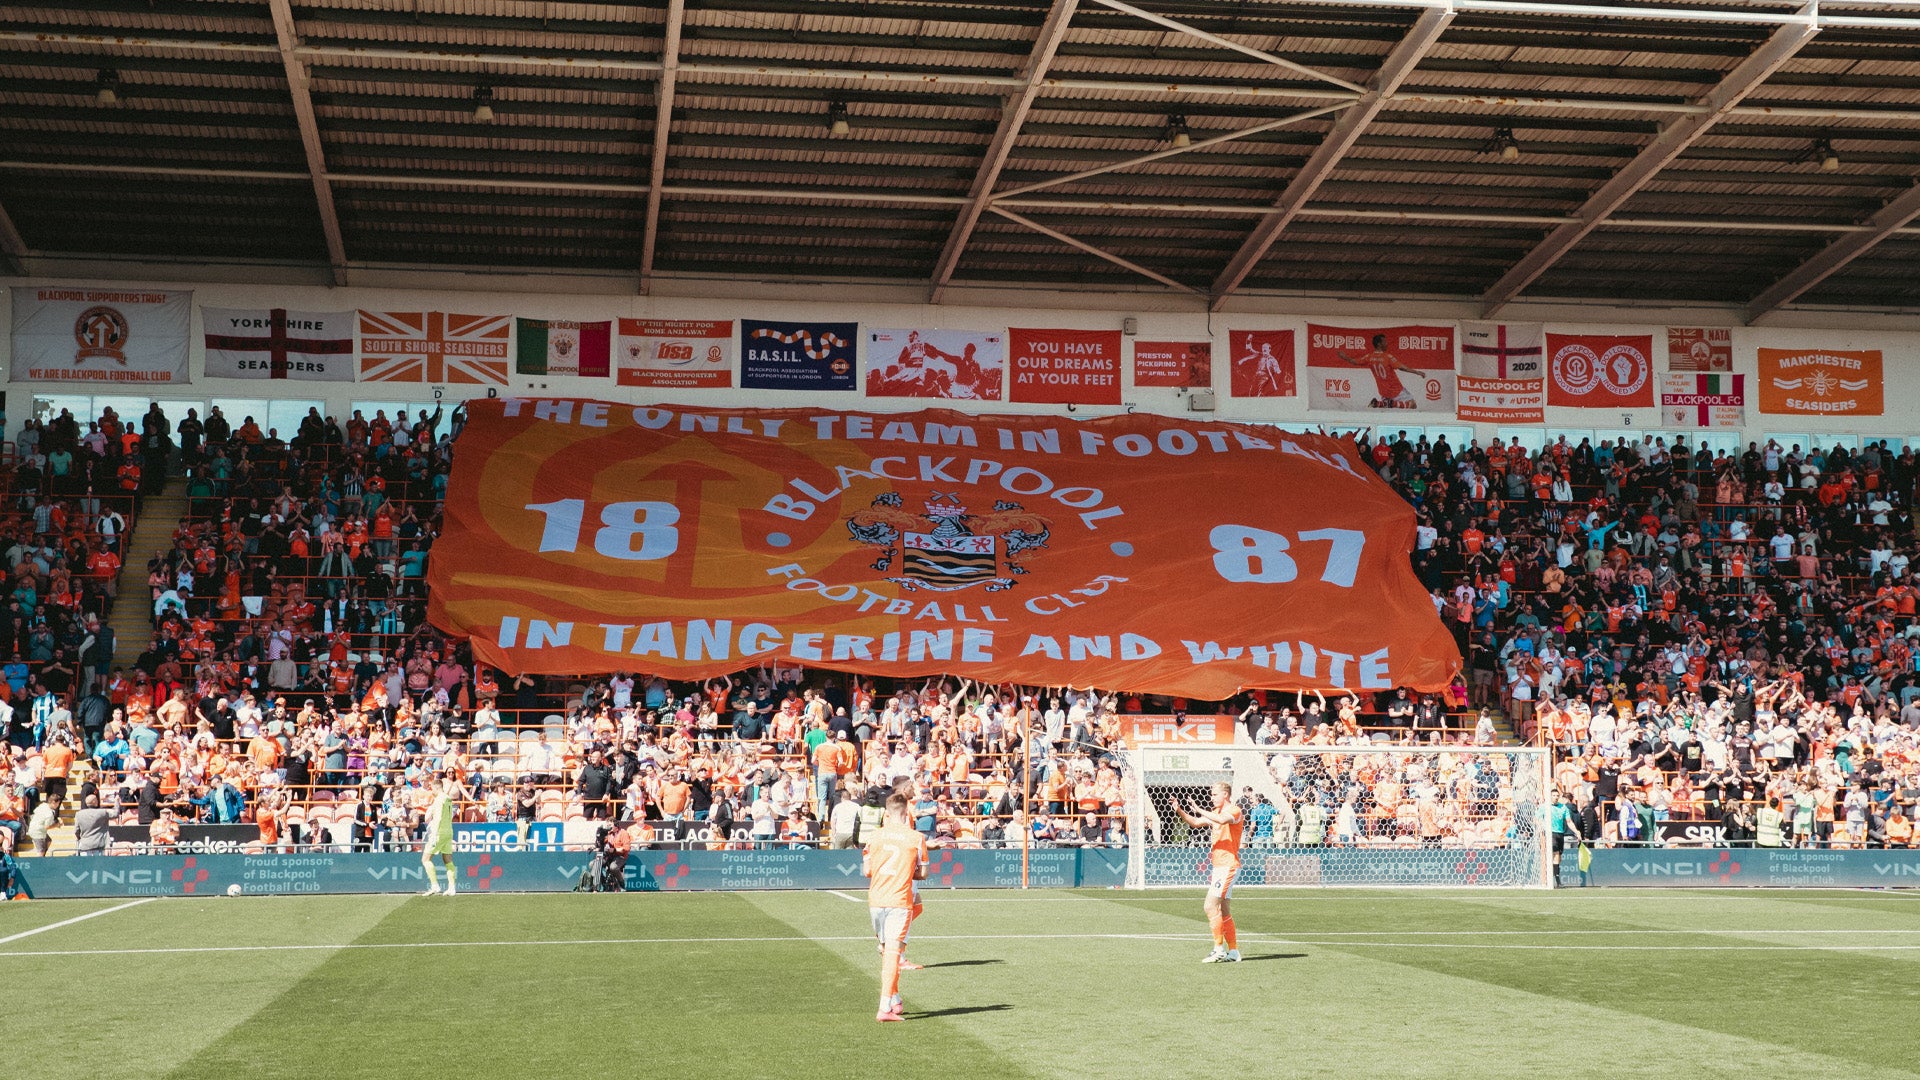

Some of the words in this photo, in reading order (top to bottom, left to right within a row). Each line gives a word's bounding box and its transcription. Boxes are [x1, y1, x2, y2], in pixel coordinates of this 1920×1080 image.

[37, 290, 85, 302] BLACKPOOL
[87, 291, 140, 303] SUPPORTERS
[141, 293, 167, 304] TRUST
[648, 320, 663, 328] THE
[665, 321, 694, 329] MIGHTY
[365, 340, 402, 353] SOUTH
[405, 341, 441, 354] SHORE
[444, 342, 504, 356] SEASIDERS
[1029, 342, 1059, 355] YOU
[1064, 342, 1103, 356] HAVE
[1313, 333, 1367, 351] SUPER
[1398, 335, 1450, 351] BRETT
[657, 341, 694, 360] bsa
[748, 349, 802, 363] B.A.S.I.L.
[1137, 352, 1173, 360] PRESTON
[1556, 345, 1598, 362] BLACKPOOL
[1614, 345, 1632, 354] LOVE
[1631, 349, 1646, 366] YOU
[238, 360, 325, 373] SEASIDERS
[1017, 356, 1051, 370] OUR
[1054, 357, 1114, 371] DREAMS
[1512, 361, 1538, 372] 2020
[1778, 354, 1862, 371] MANCHESTER
[29, 368, 43, 379] WE
[44, 369, 60, 380] ARE
[61, 370, 108, 381] BLACKPOOL
[109, 370, 150, 382] FOOTBALL
[151, 371, 172, 381] CLUB
[632, 371, 672, 379] BLACKPOOL
[1018, 373, 1035, 386] AT
[1039, 373, 1080, 387] YOUR
[1084, 374, 1114, 388] FEET
[1325, 378, 1352, 392] FY6
[1460, 380, 1527, 392] BLACKPOOL
[1527, 381, 1541, 391] FC
[1555, 374, 1586, 395] FOOTBALL
[1586, 376, 1600, 392] CLUB
[1603, 378, 1629, 395] INDEED
[434, 390, 442, 399] D
[487, 387, 497, 399] D
[1663, 395, 1725, 405] BLACKPOOL
[1726, 395, 1742, 405] FC
[1067, 403, 1077, 412] C
[1510, 396, 1541, 405] #UTMP
[1785, 397, 1858, 412] SEASIDERS
[1127, 406, 1135, 415] C
[1460, 409, 1473, 417] SIR
[1473, 410, 1504, 419] STANLEY
[1505, 411, 1542, 419] MATTHEWS
[502, 398, 610, 429] THE
[631, 408, 787, 439] ONLY
[809, 414, 979, 448] TEAM
[998, 427, 1063, 455] IN
[1624, 418, 1631, 426] B
[763, 455, 1125, 531] BLACKPOOL
[524, 498, 681, 562] 18
[1209, 525, 1366, 588] 87
[766, 562, 1009, 622] FOOTBALL
[498, 616, 575, 650] IN
[598, 618, 994, 664] TANGERINE
[1018, 632, 1162, 664] AND
[1179, 640, 1392, 689] WHITE
[1222, 757, 1232, 769] 2
[1685, 825, 1729, 847] SBK
[243, 857, 276, 870] Proud
[281, 857, 334, 870] sponsors
[721, 853, 753, 865] Proud
[757, 853, 806, 867] sponsors
[880, 843, 899, 876] 2
[1029, 853, 1076, 866] sponsors
[1769, 851, 1798, 863] Proud
[1801, 852, 1845, 865] sponsors
[721, 865, 733, 876] of
[736, 864, 789, 879] Blackpool
[994, 864, 1006, 873] of
[1622, 861, 1703, 876] VINCI
[1769, 864, 1780, 874] of
[1782, 863, 1830, 876] Blackpool
[65, 869, 162, 885] VINCI
[243, 869, 257, 881] of
[260, 869, 316, 884] Blackpool
[721, 876, 766, 888] Football
[769, 876, 794, 887] Club
[1040, 875, 1064, 885] Club
[1769, 875, 1811, 885] Football
[1813, 875, 1835, 885] Club
[127, 886, 177, 895] BUILDING
[243, 881, 289, 893] Football
[294, 881, 321, 892] Club
